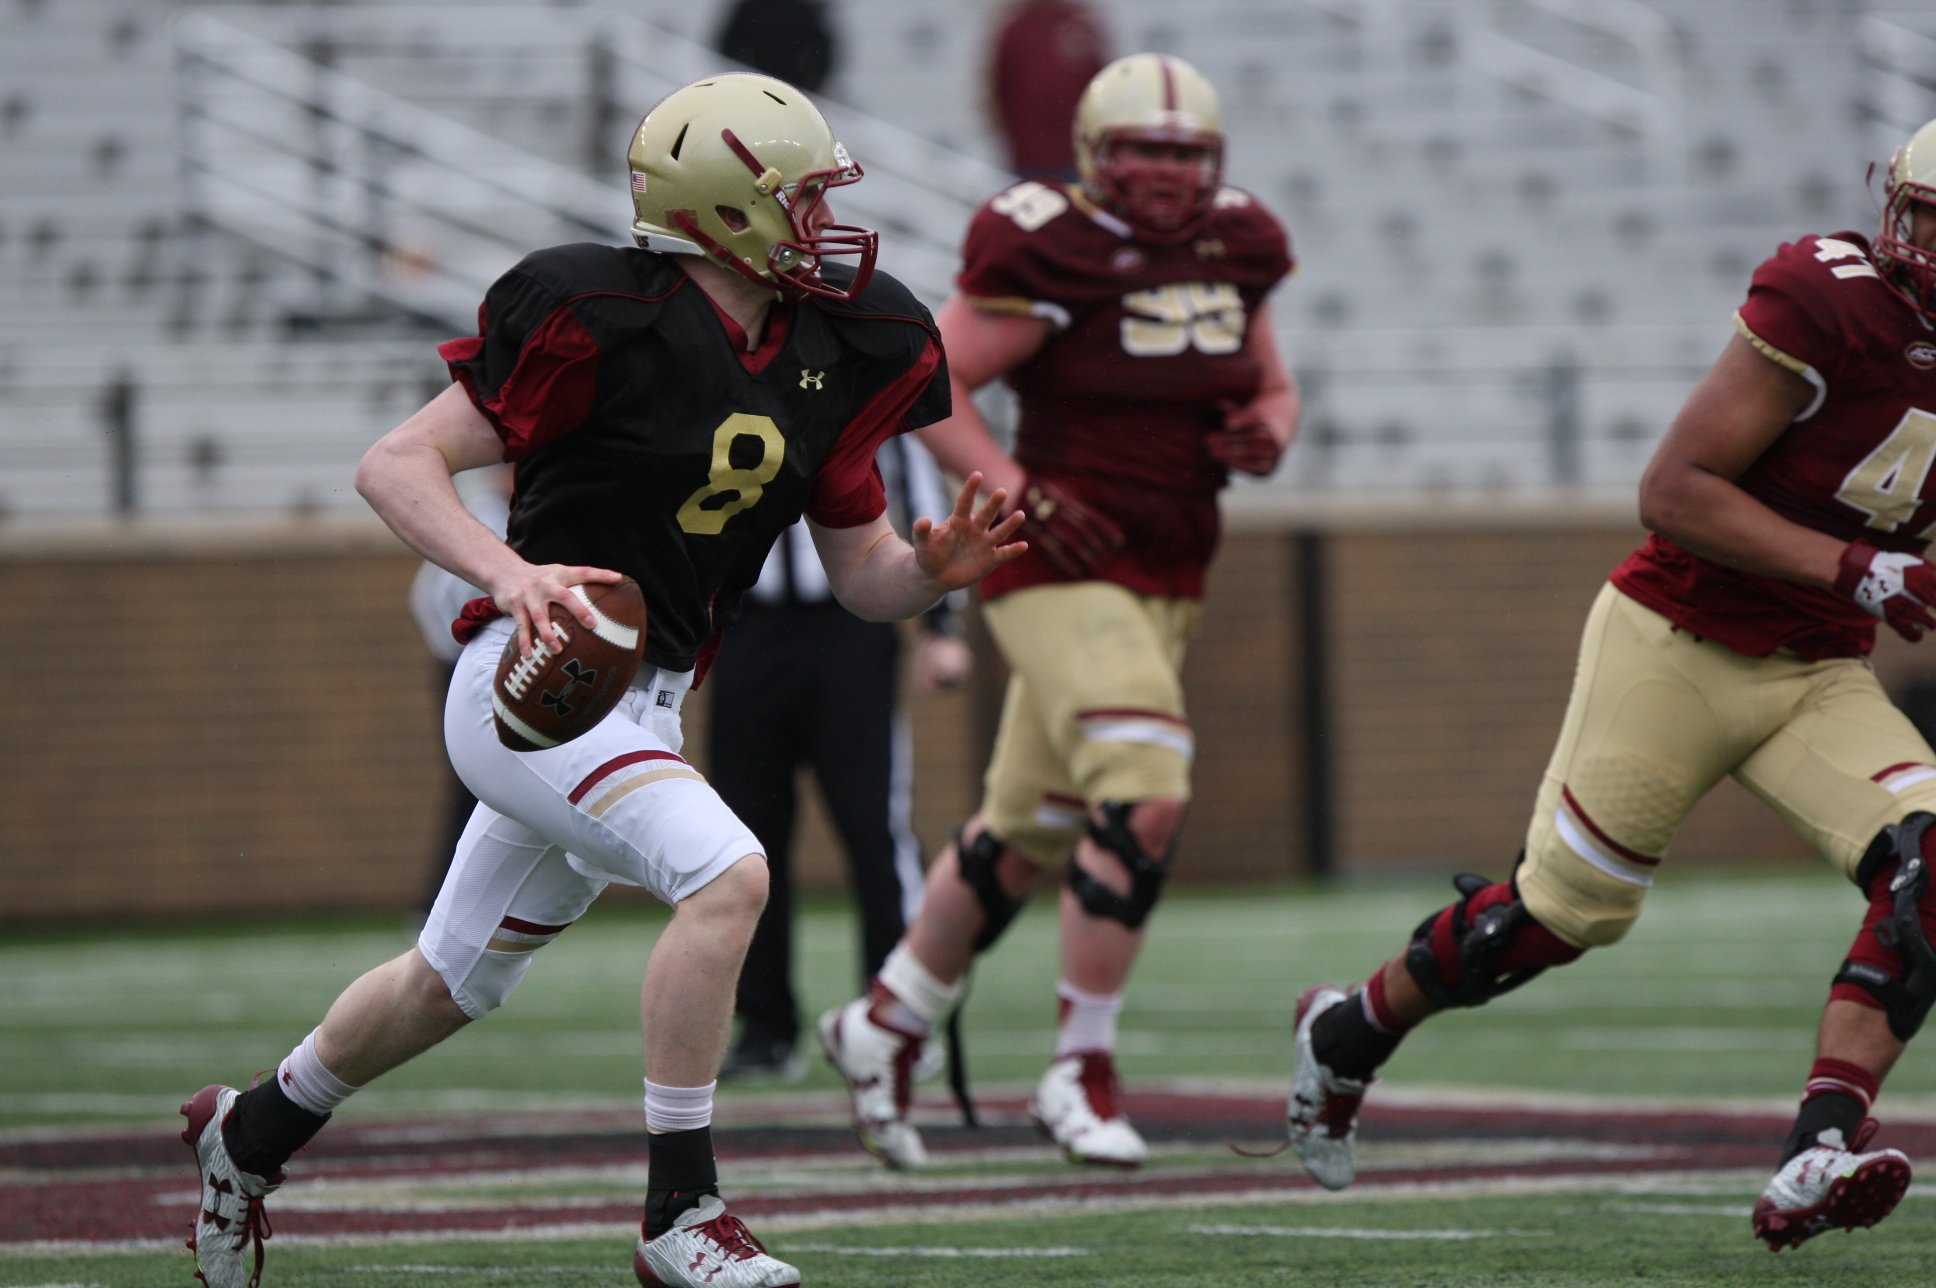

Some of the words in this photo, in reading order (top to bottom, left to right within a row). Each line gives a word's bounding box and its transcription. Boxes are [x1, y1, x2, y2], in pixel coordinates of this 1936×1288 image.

[1813, 237, 1881, 280] 47
[676, 412, 785, 535] 8
[1833, 406, 1936, 537] 4
